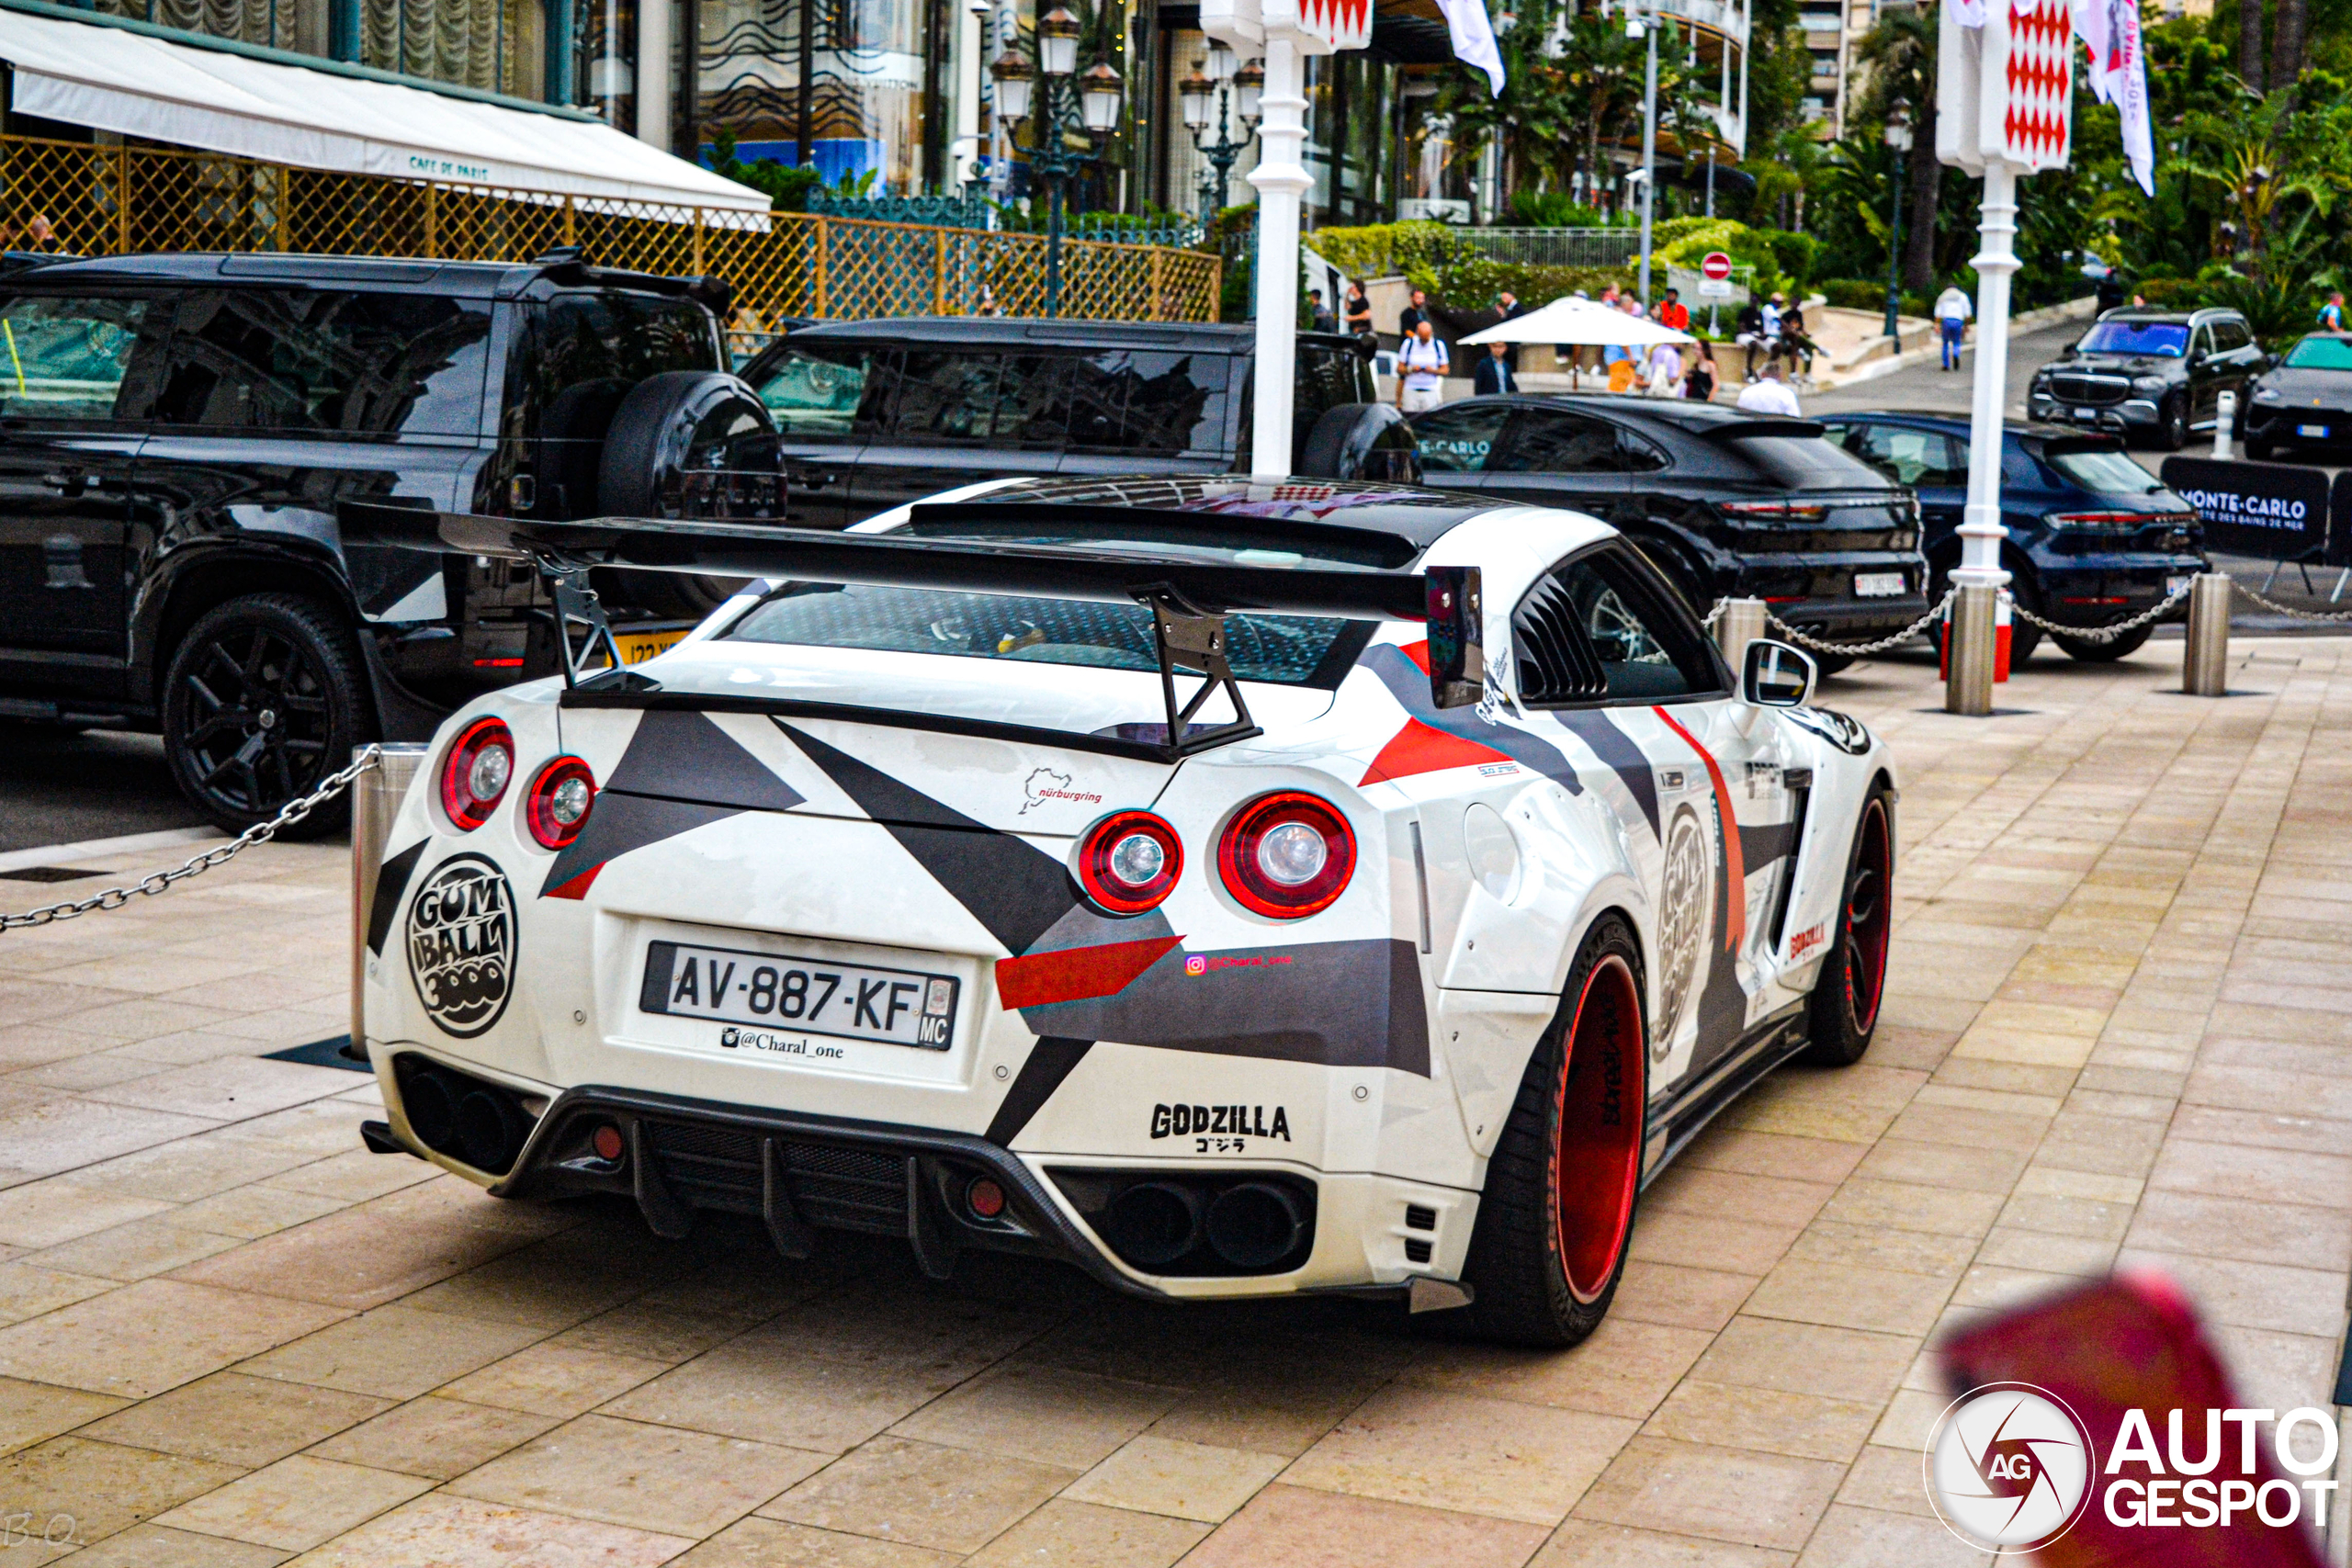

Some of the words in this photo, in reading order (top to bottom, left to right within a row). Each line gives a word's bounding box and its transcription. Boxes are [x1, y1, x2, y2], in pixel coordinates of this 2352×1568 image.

[458, 164, 488, 181] PARIS
[1038, 788, 1102, 804] nürburgring
[414, 878, 505, 931] GUM
[413, 915, 507, 973] BALL
[1208, 954, 1293, 971] @Charal_one
[425, 961, 506, 1012] 3000
[673, 956, 920, 1032] AV-887-KF
[920, 1016, 947, 1043] MC
[741, 1032, 844, 1059] @Charal_one
[1150, 1103, 1291, 1142] GODZILLA
[1195, 1137, 1245, 1153] ゴジラ
